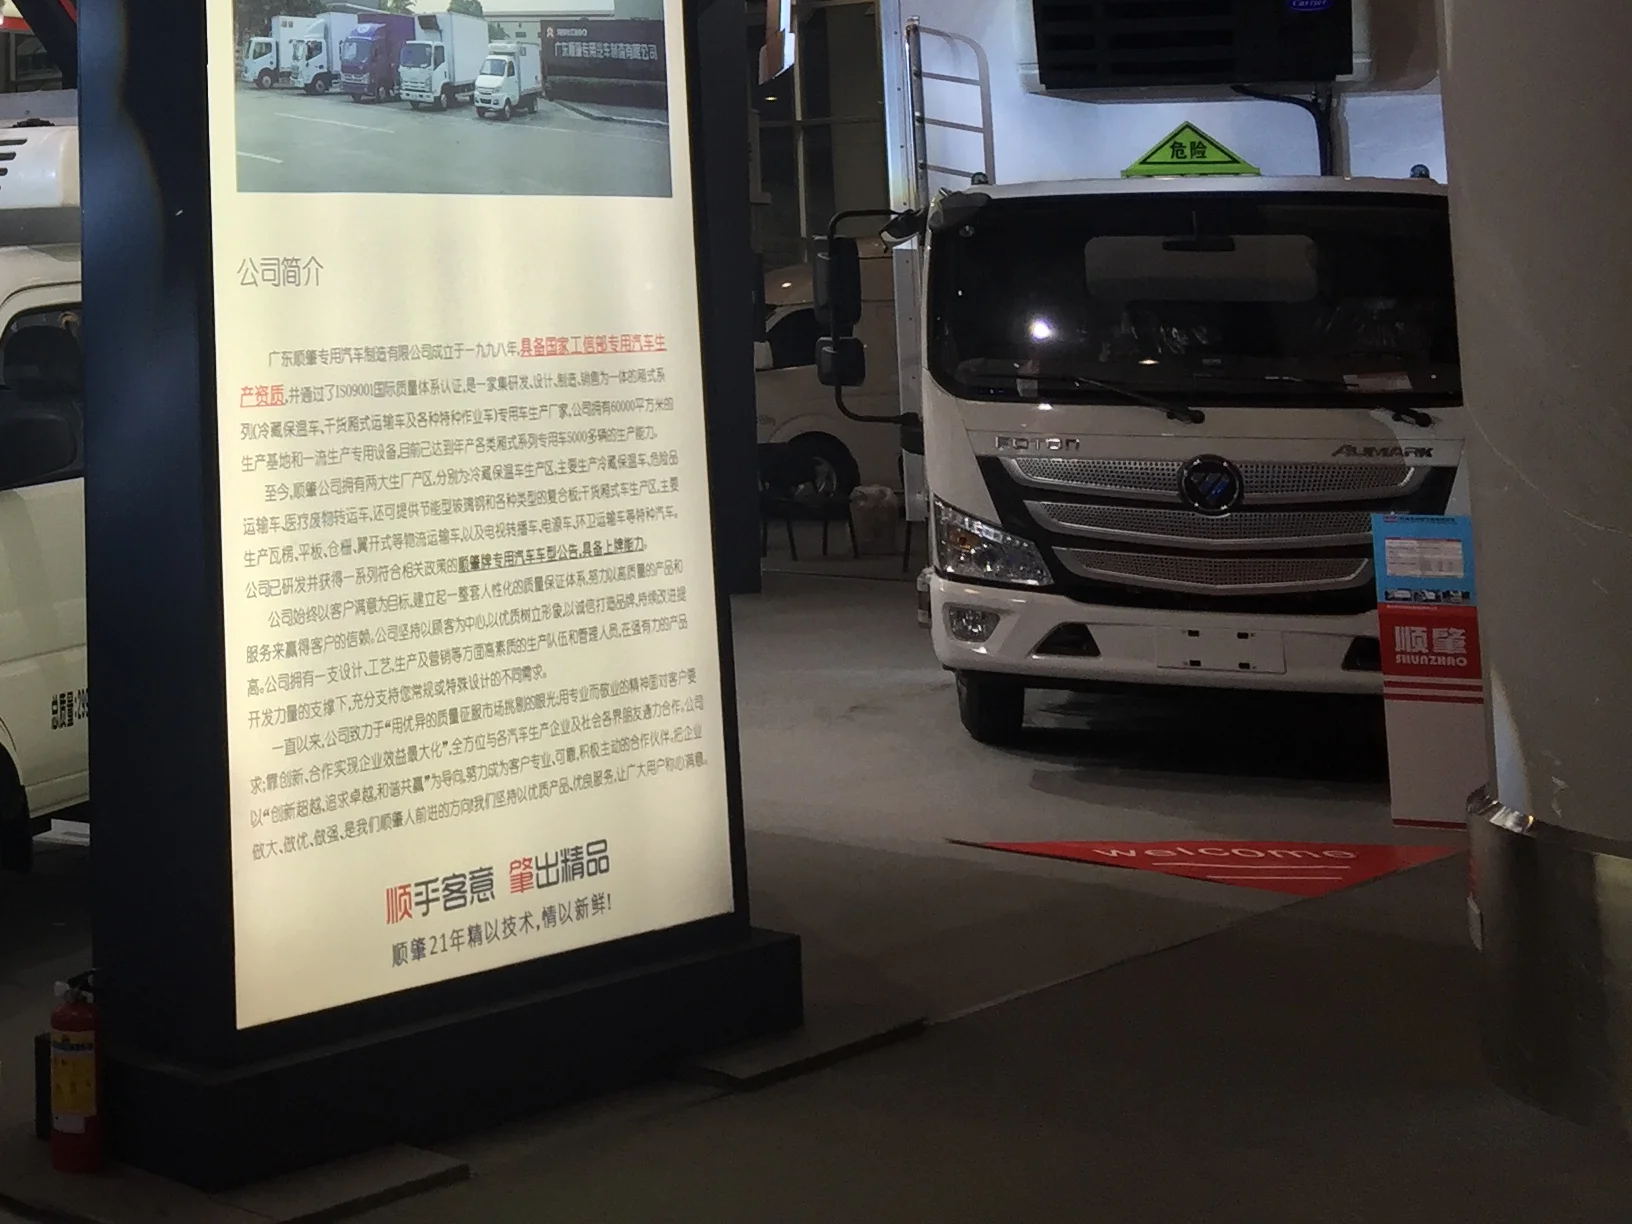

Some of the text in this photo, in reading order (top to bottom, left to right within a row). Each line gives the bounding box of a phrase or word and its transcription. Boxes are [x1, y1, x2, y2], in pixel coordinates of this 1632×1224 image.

[1170, 139, 1207, 161] 危险
[237, 255, 325, 288] 公司简介
[1332, 443, 1434, 459] AUMARK
[1395, 626, 1466, 654] 顺肇
[1396, 654, 1468, 667] SHUNZHAO
[1092, 843, 1359, 862] welcome
[386, 839, 611, 925] 顺乎客意 肇出精品
